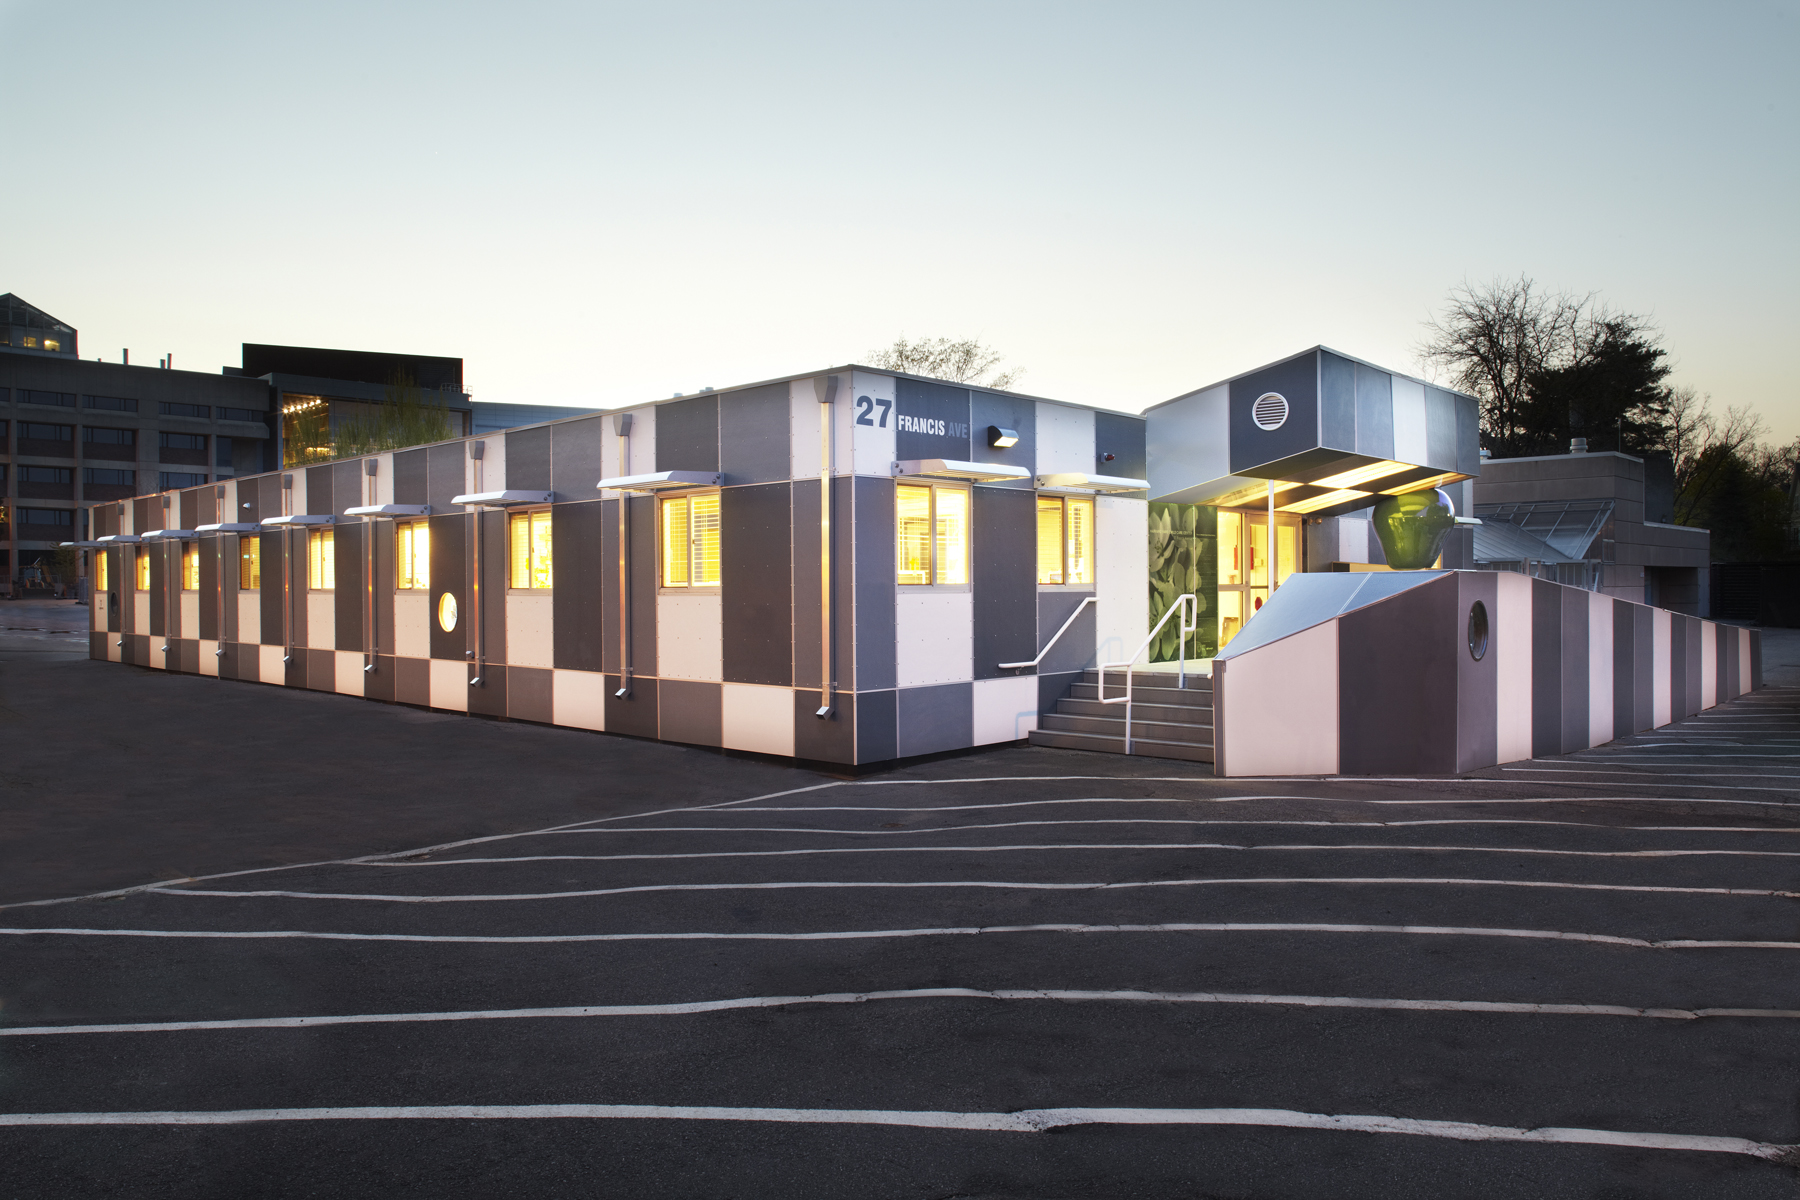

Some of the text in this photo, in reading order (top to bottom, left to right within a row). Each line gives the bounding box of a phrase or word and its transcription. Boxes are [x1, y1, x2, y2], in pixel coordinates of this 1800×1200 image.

[856, 395, 968, 438] 27 FRANCIS AVE
